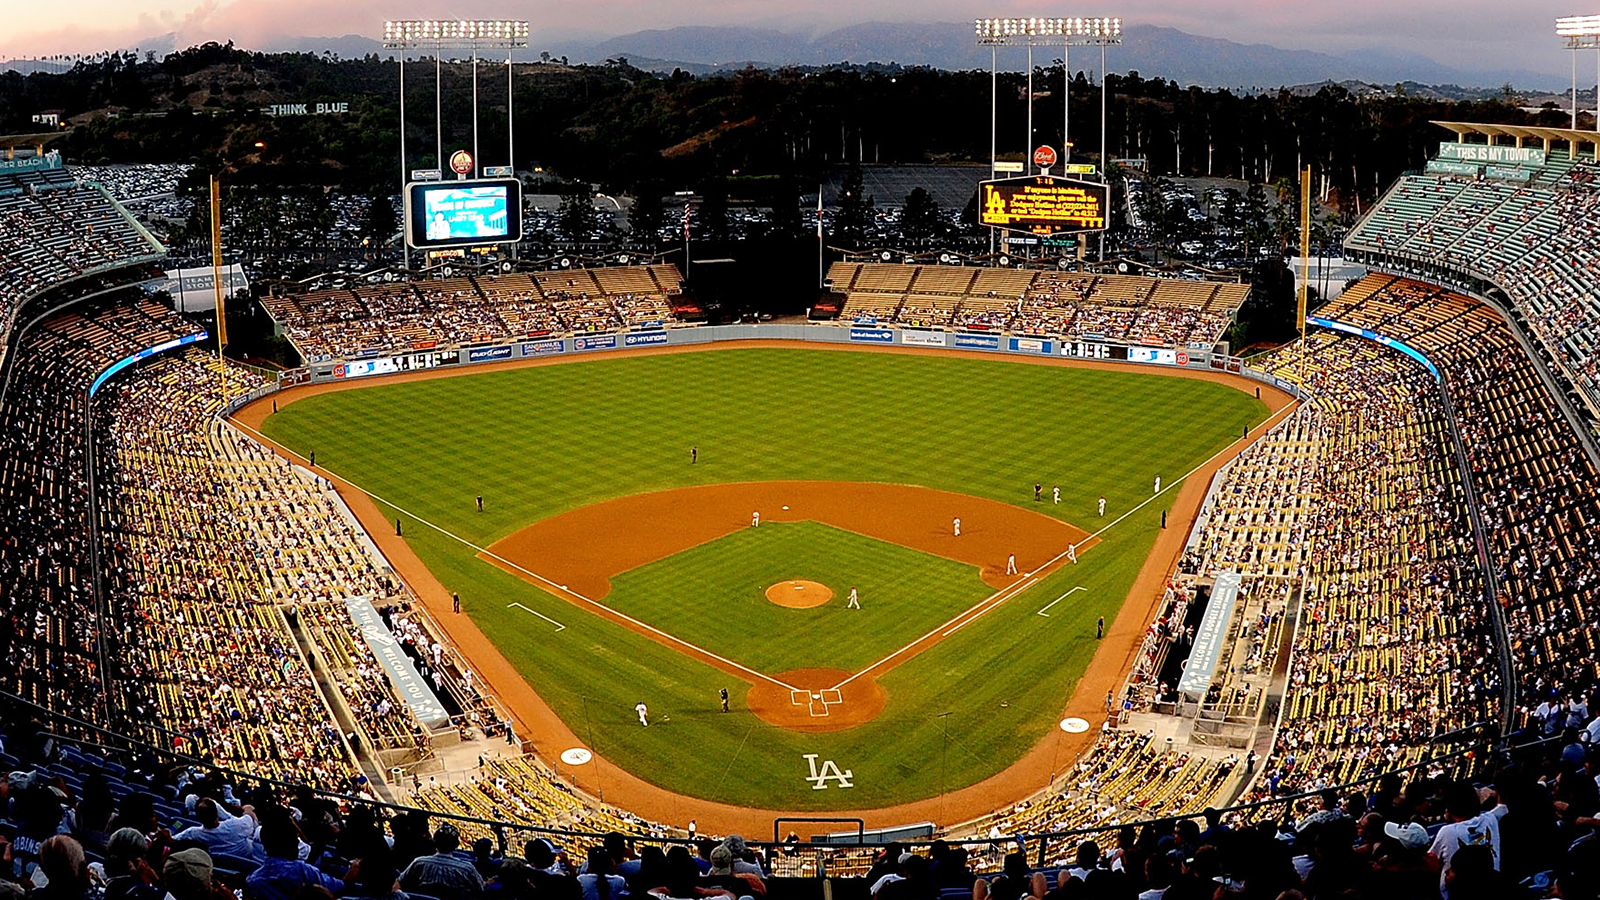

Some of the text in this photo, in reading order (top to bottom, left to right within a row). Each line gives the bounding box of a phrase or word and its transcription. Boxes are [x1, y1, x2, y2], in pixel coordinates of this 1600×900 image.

[270, 102, 348, 115] THINK BLUE
[1456, 147, 1529, 161] THIS IS MY TOWN
[17, 158, 43, 167] BEACH
[985, 184, 1006, 214] LA
[637, 334, 666, 342] HYUNDAI
[359, 612, 375, 627] THE
[381, 647, 411, 682] WELCOME
[405, 682, 424, 699] YOU
[802, 753, 854, 790] LA
